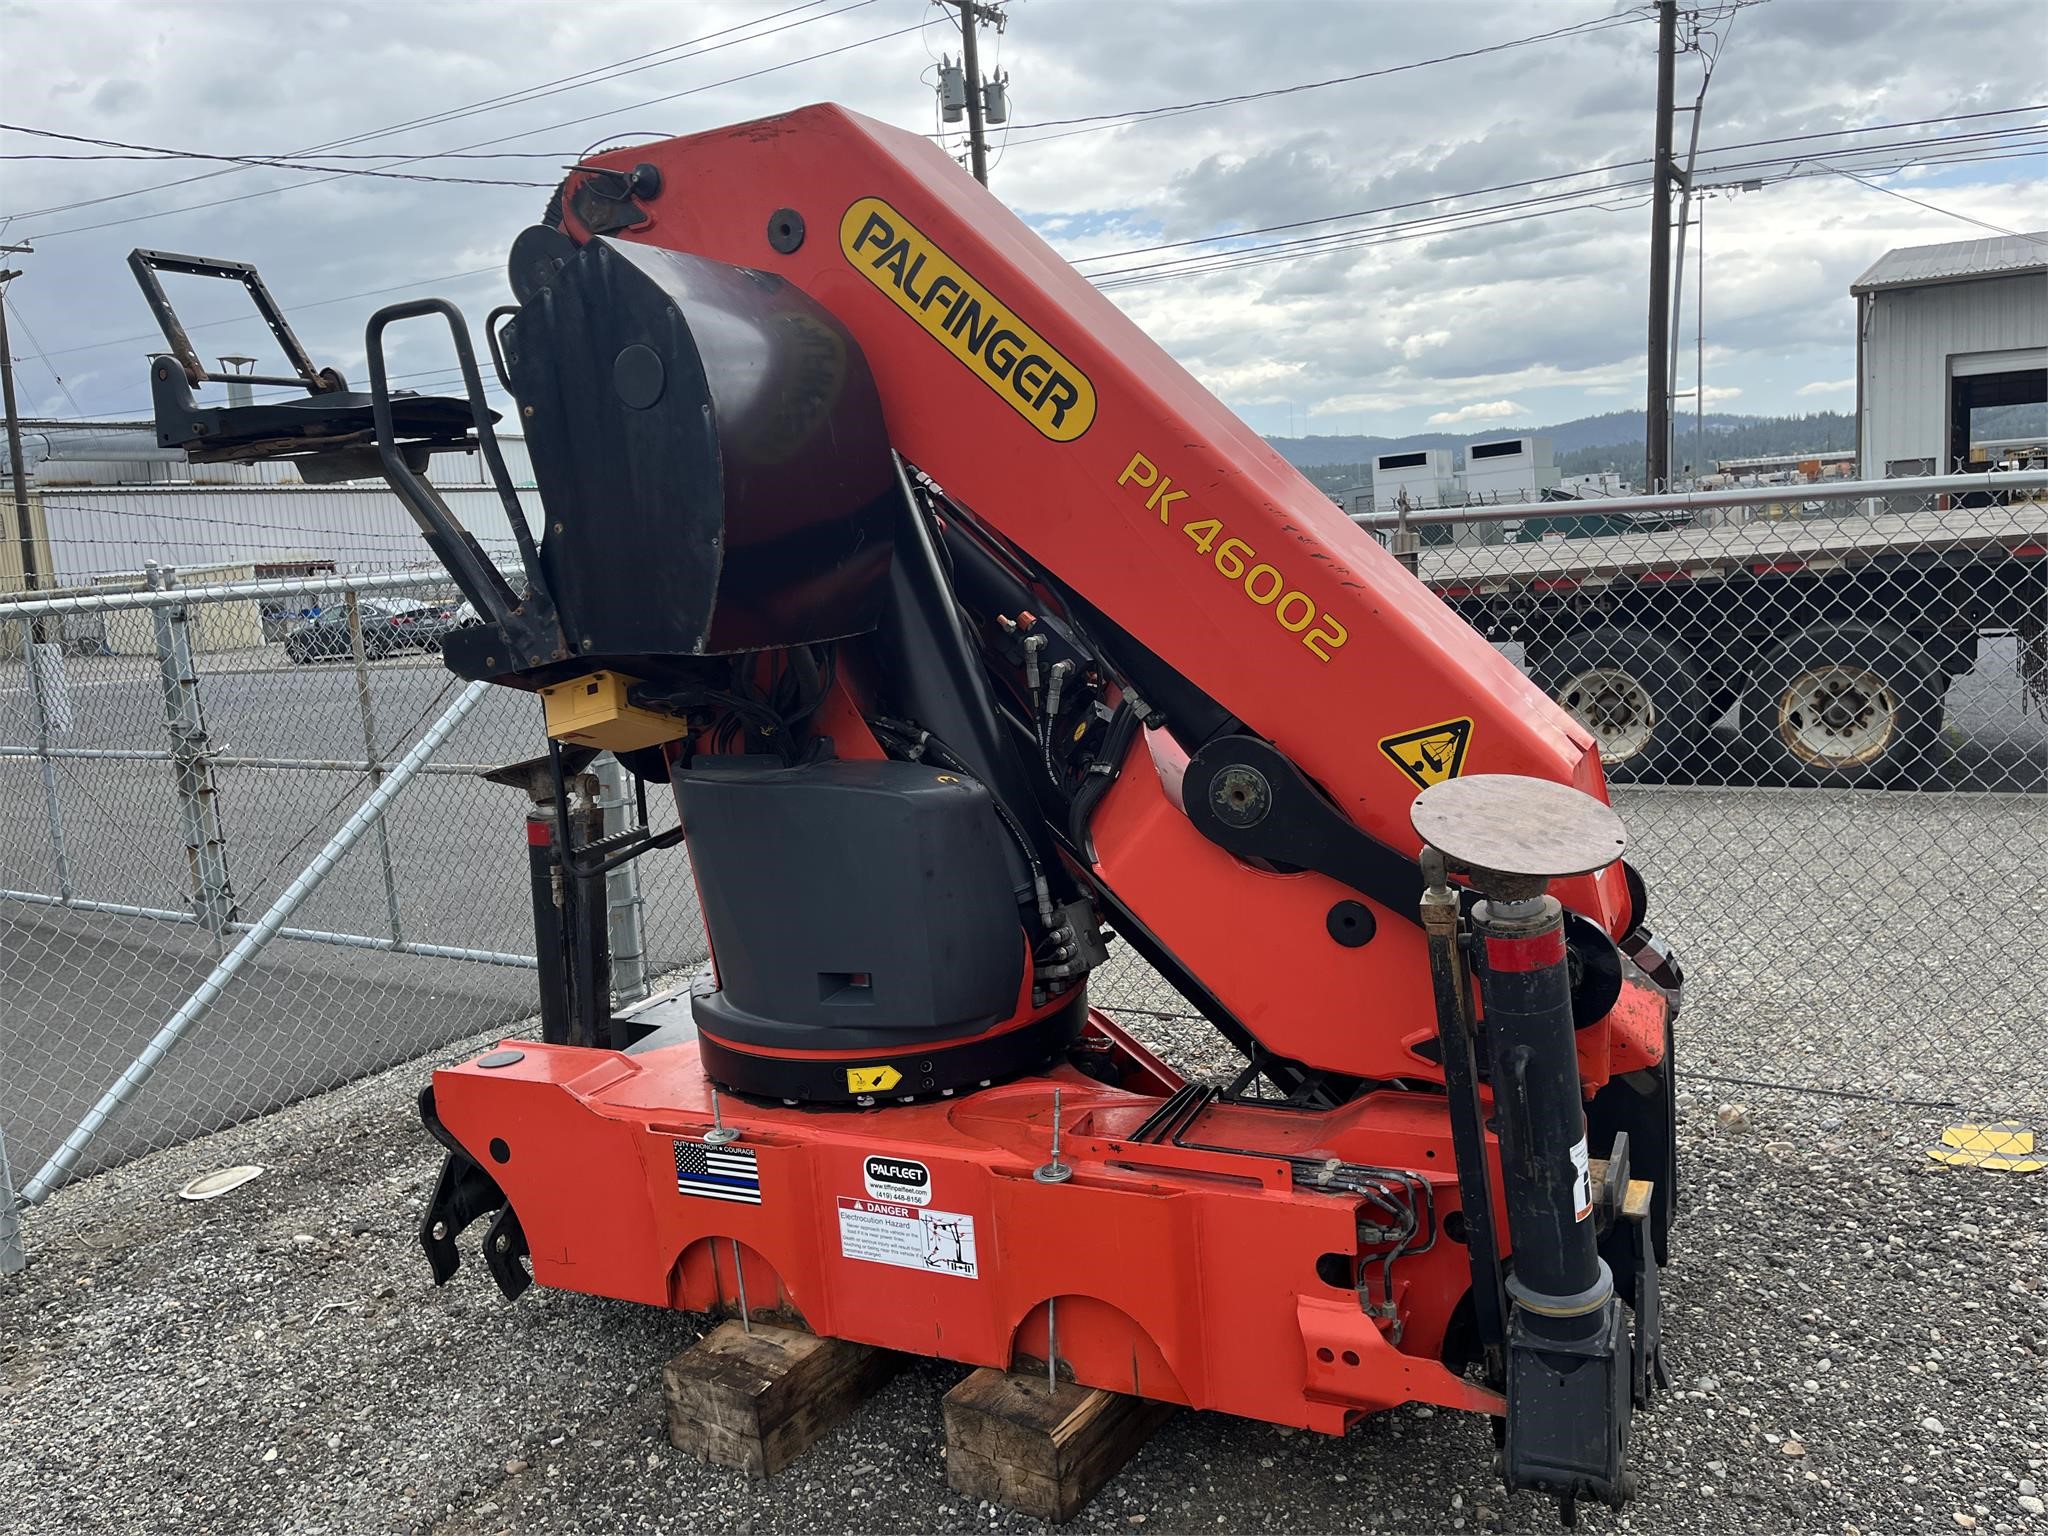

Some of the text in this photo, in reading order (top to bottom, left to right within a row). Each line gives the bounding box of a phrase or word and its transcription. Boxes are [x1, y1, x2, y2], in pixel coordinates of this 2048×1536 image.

[852, 211, 1078, 429] PALFINGER
[1116, 450, 1349, 663] PK 46002
[673, 1139, 755, 1156] DUTY HONOR COURAGE
[870, 1163, 923, 1181] PALFLEET
[877, 1191, 892, 1200] (419)
[867, 1203, 909, 1217] DANGER
[840, 1212, 910, 1230] Electrocution Hazard
